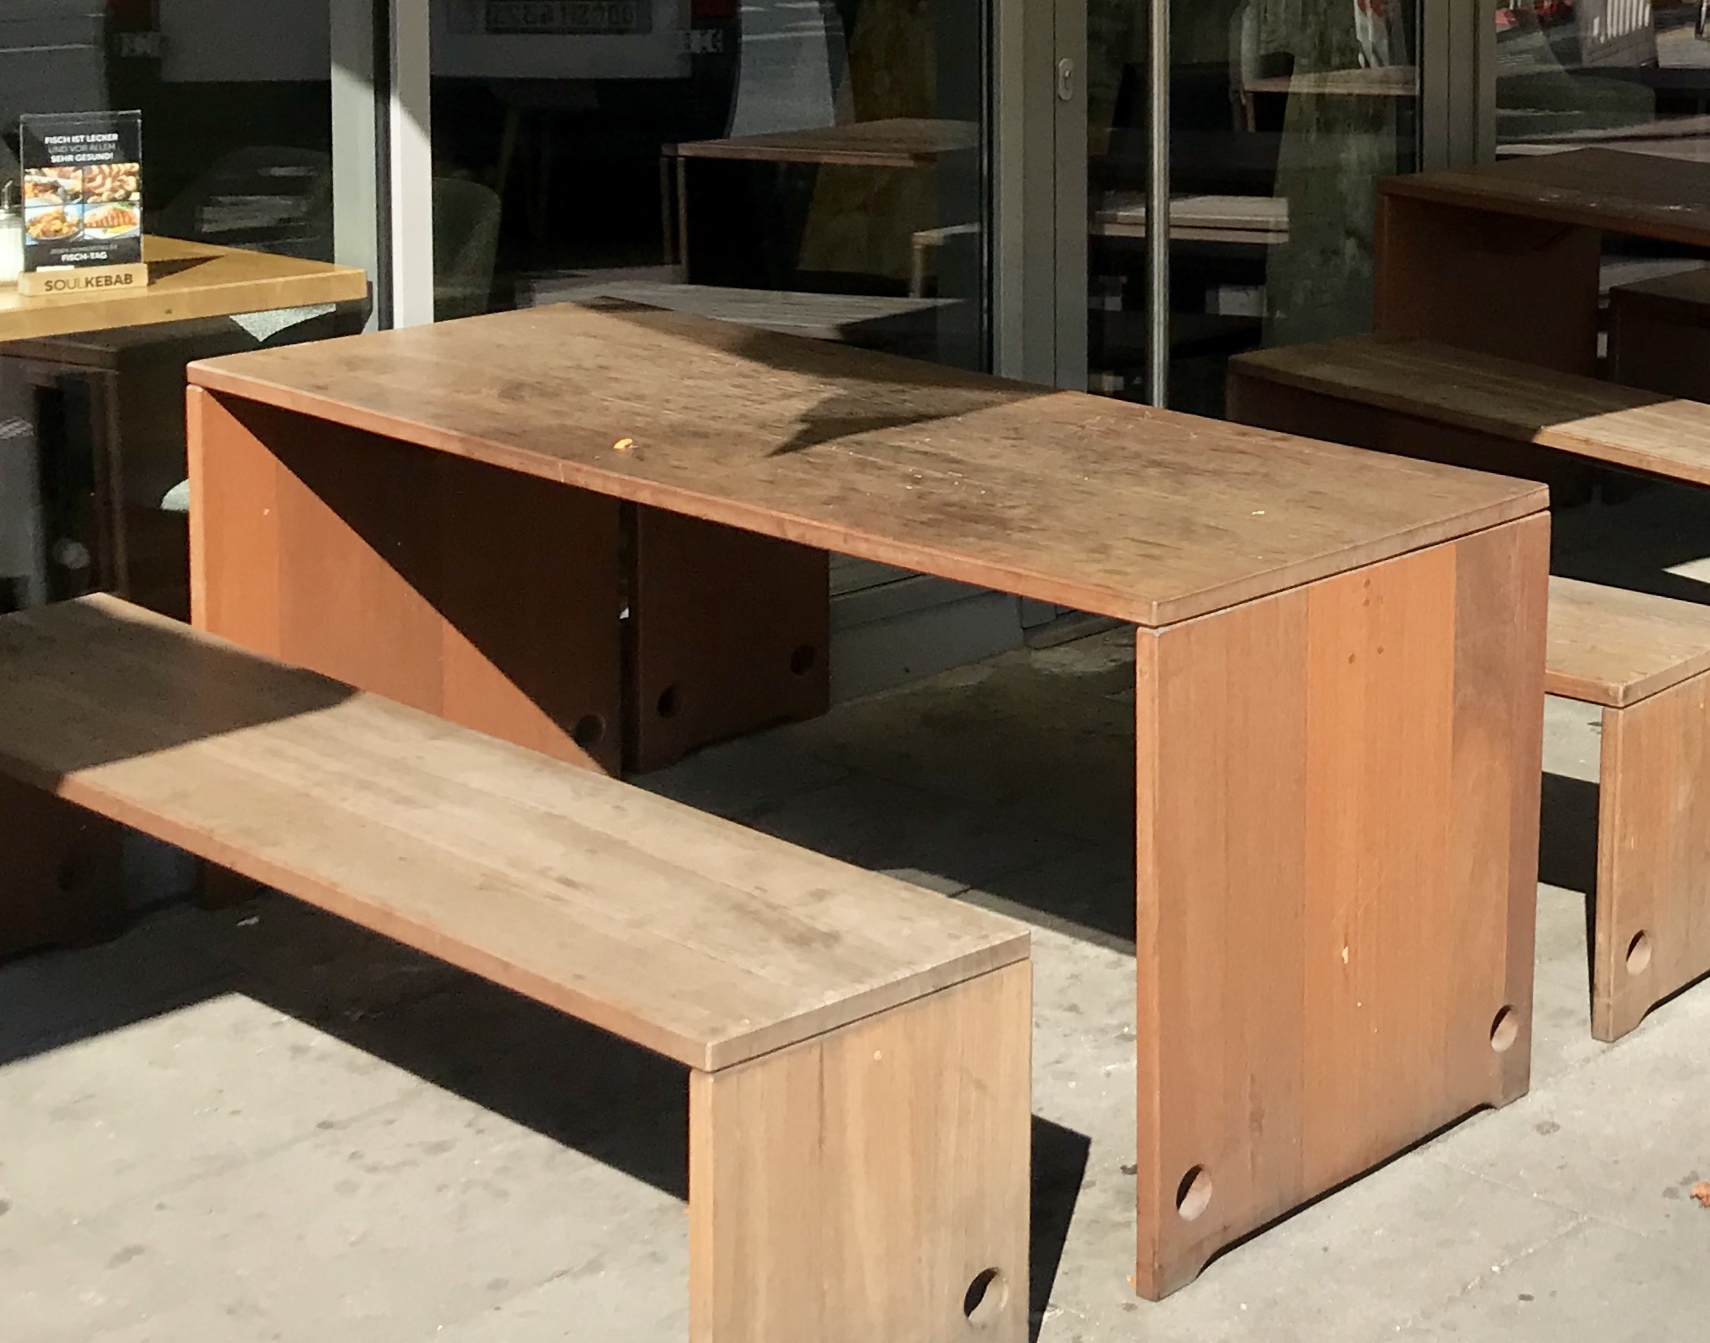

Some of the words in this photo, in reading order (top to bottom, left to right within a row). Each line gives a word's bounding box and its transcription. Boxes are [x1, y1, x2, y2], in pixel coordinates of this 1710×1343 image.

[44, 135, 71, 145] FISCH
[71, 134, 85, 143] IST
[86, 133, 119, 143] LECKER
[48, 145, 68, 154] UND
[69, 144, 88, 153] VOR
[89, 142, 116, 152] ALLEM
[50, 154, 74, 163] SEHR
[44, 273, 133, 292] SOULKEBAB
